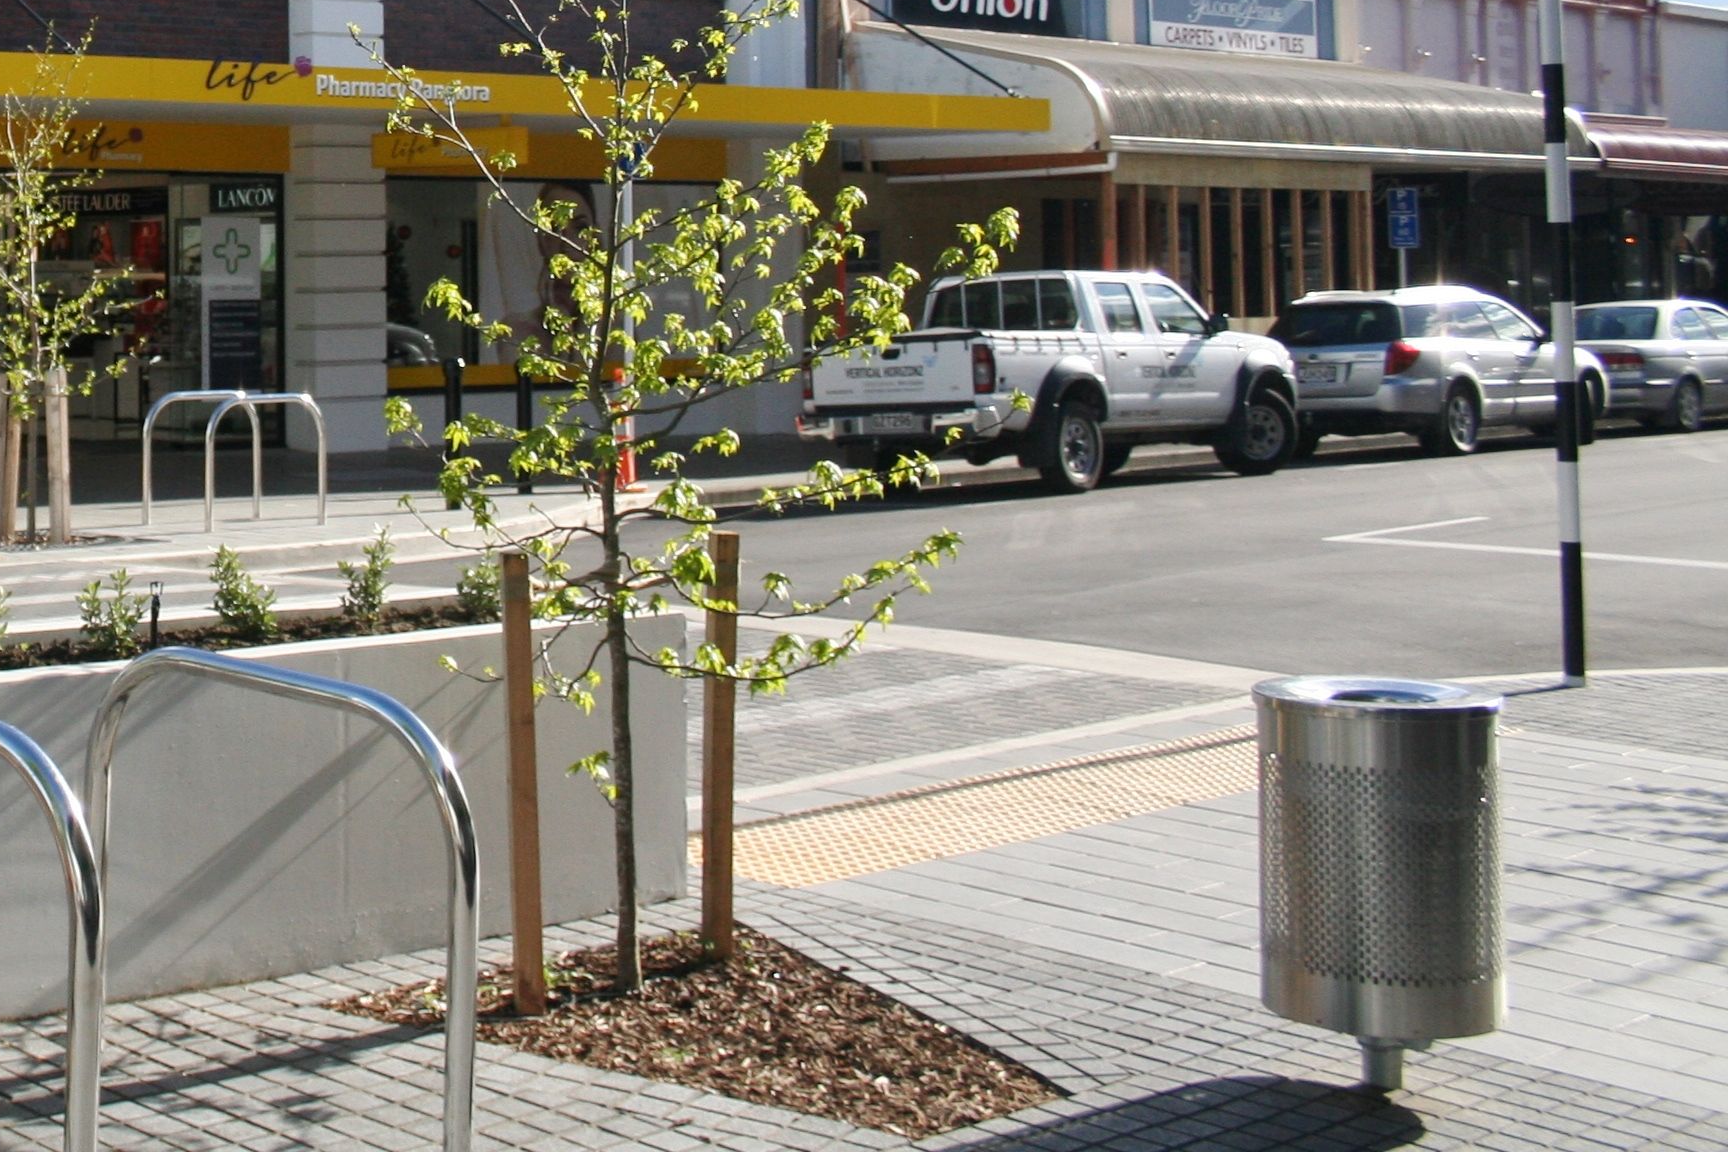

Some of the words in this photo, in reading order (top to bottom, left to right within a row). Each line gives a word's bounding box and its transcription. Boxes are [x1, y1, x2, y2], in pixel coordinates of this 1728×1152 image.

[1165, 26, 1215, 47] CARPETS
[1226, 32, 1268, 51] VINYLS
[1278, 36, 1305, 55] TILES
[205, 50, 295, 101] life
[315, 74, 408, 101] Pharmacy
[408, 78, 491, 106] Ranora
